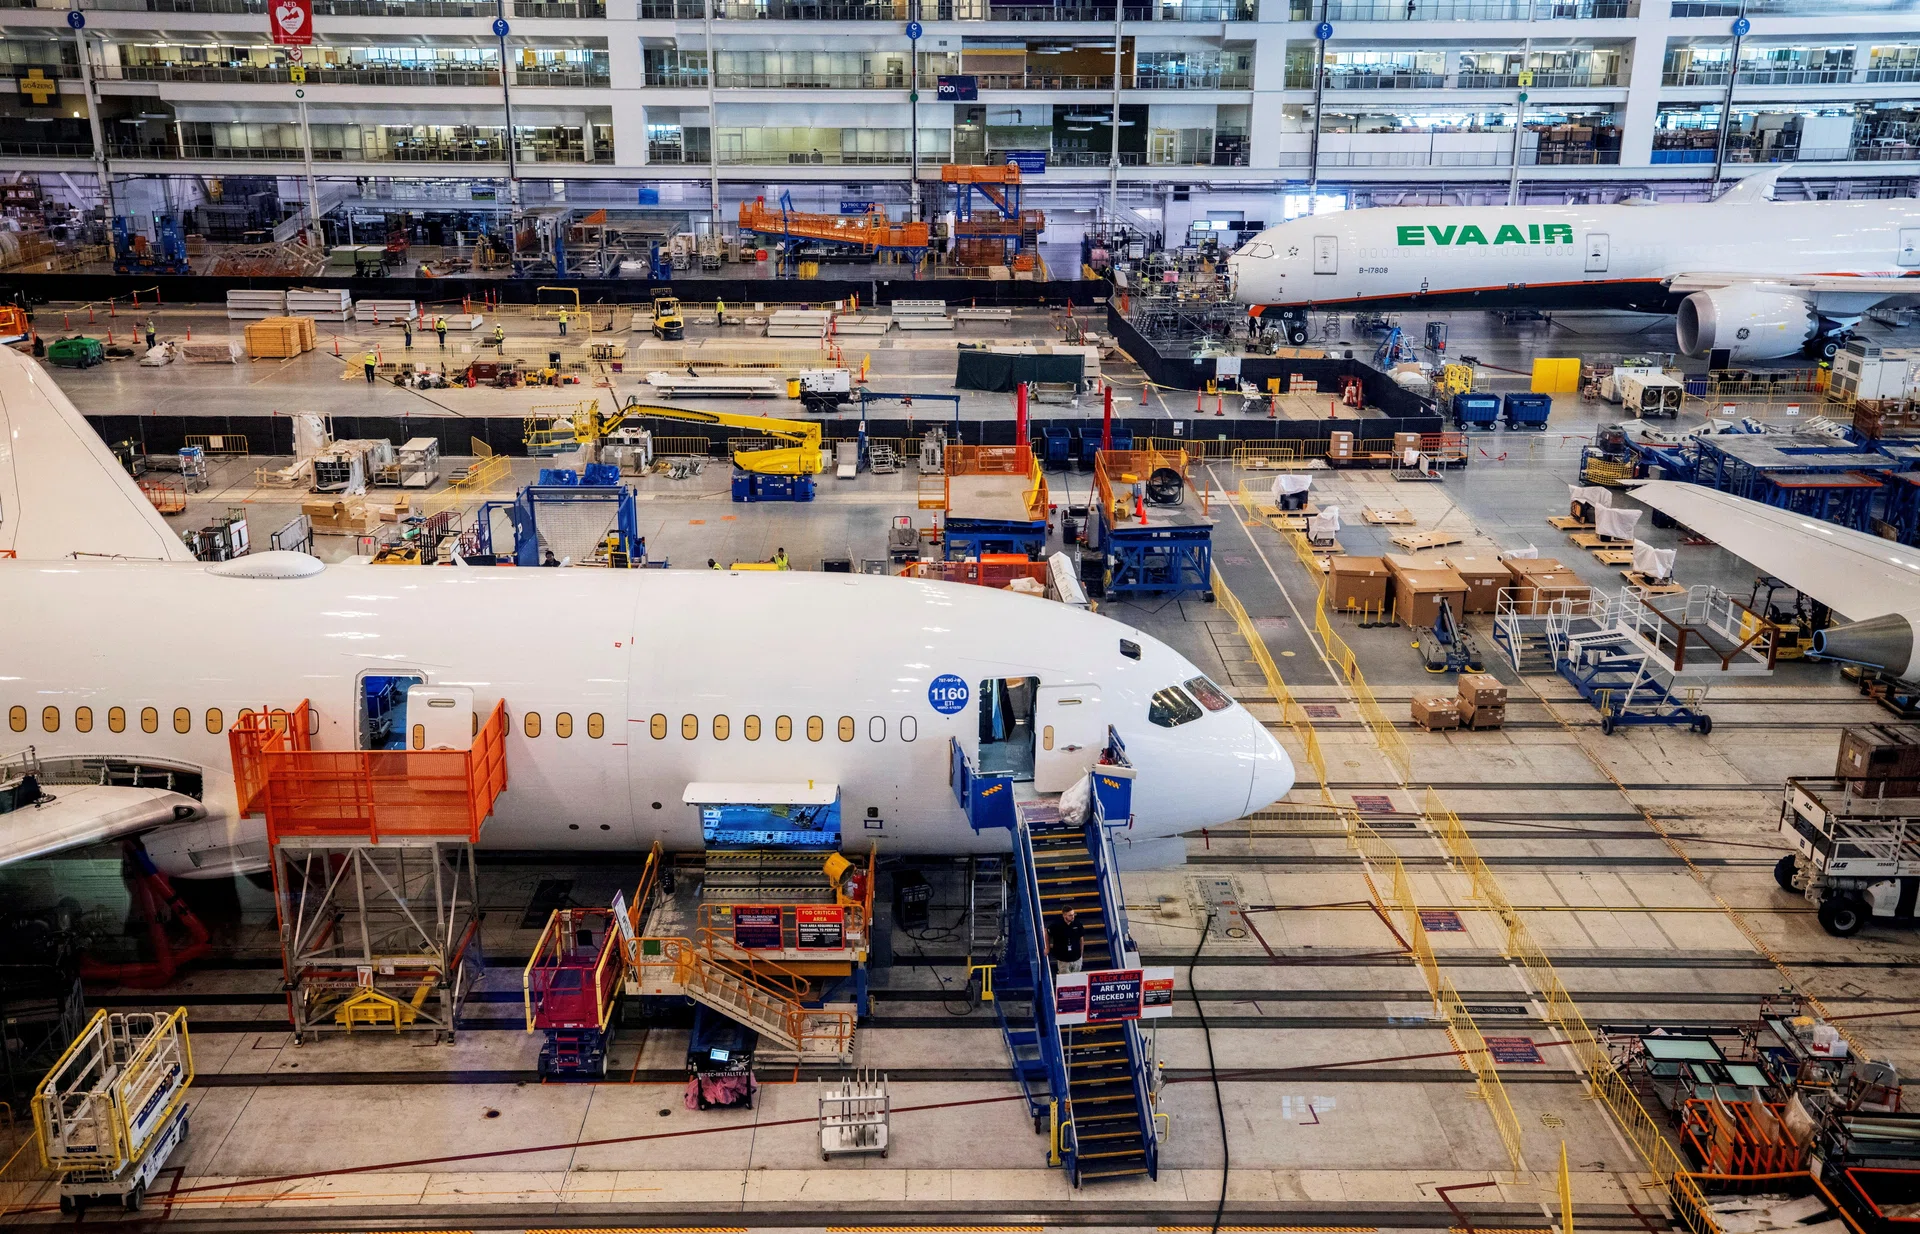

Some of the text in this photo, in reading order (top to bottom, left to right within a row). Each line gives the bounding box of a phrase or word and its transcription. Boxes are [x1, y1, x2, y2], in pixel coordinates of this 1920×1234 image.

[932, 688, 967, 700] 1160
[1804, 802, 1812, 811] JLG
[359, 969, 370, 985] 7
[1091, 993, 1124, 1001] CHECKED
